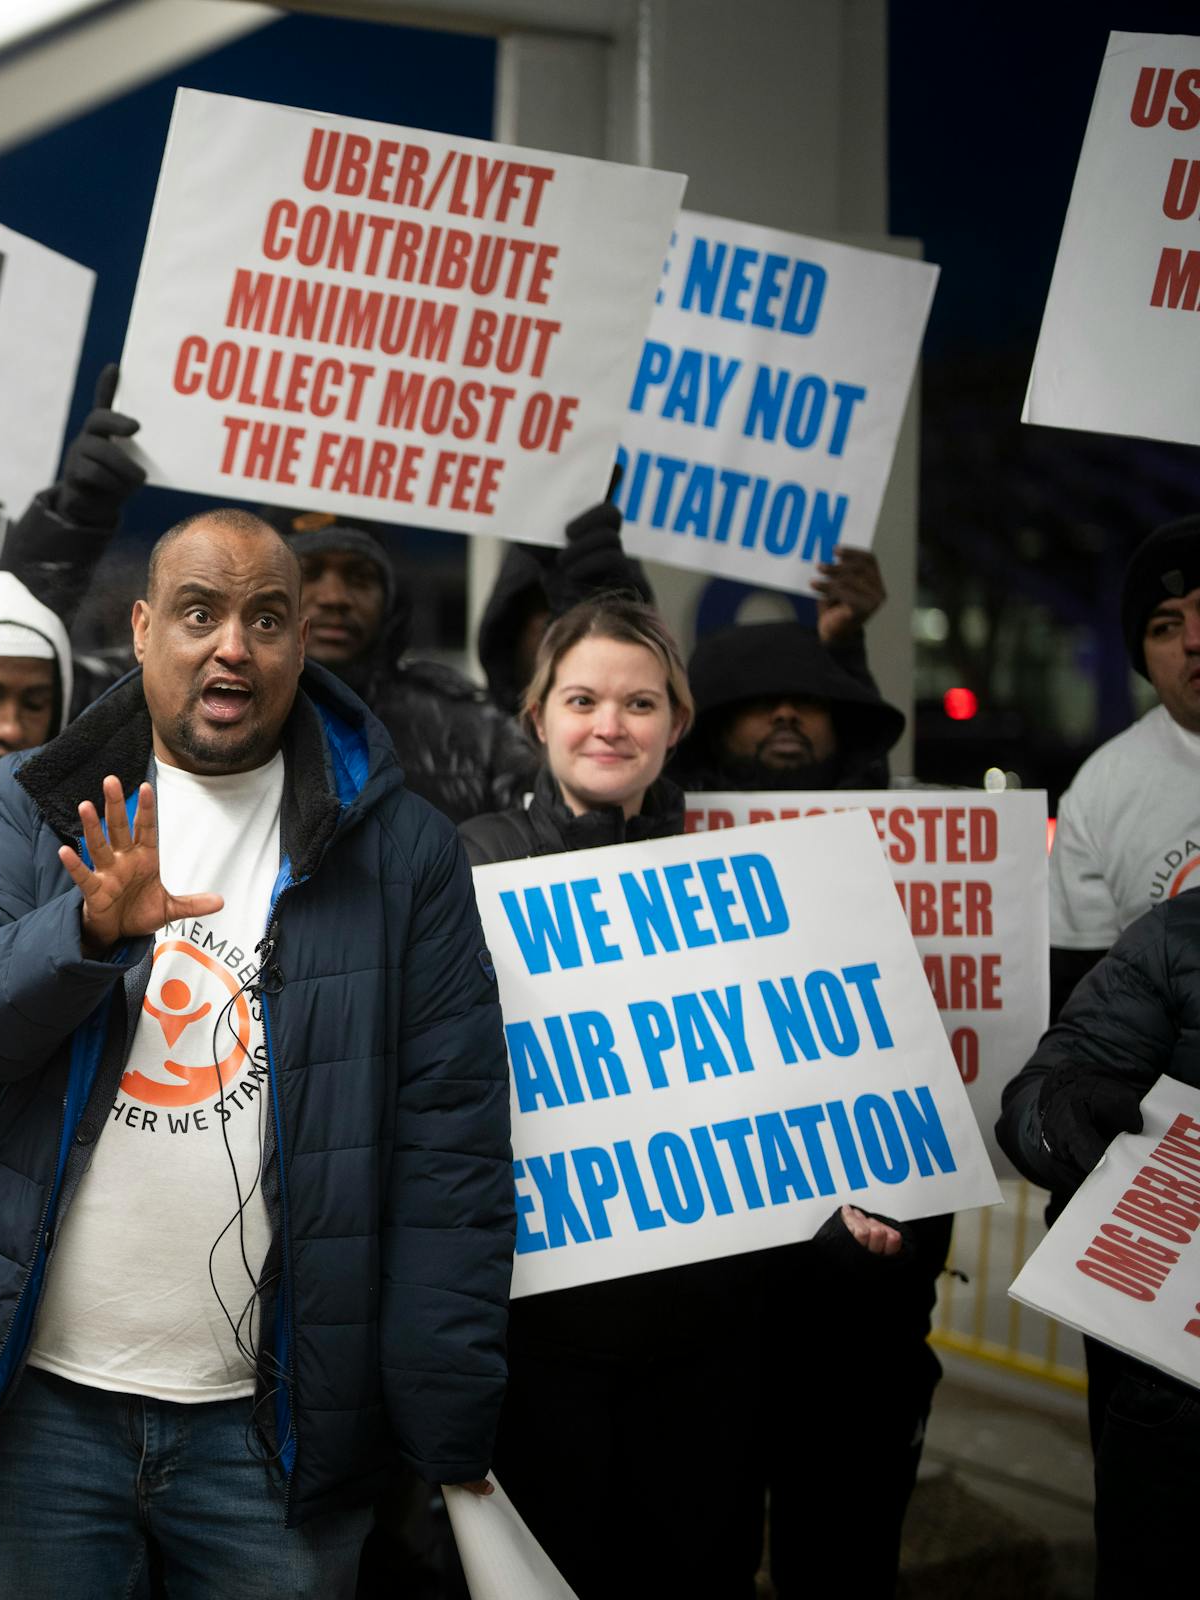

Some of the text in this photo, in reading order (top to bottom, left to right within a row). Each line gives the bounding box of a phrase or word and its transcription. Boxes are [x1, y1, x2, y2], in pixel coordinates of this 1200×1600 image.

[302, 127, 555, 228] UBER/LYFT
[262, 198, 560, 306] CONTRIBUTE
[680, 236, 828, 337] NEED
[225, 268, 561, 379] MINIMUM BUT
[173, 335, 579, 455] COLLECT MOST OF
[628, 338, 867, 458] PAY NOT
[219, 415, 506, 516] THE FARE FEE
[499, 852, 790, 975] WE NEED
[894, 881, 994, 937] BER
[168, 1109, 209, 1134] WE
[214, 1045, 269, 1123] STAND
[504, 962, 895, 1114] AIR PAY NOT
[512, 1084, 958, 1256] EXPLOITATION
[1075, 1223, 1181, 1303] OMG
